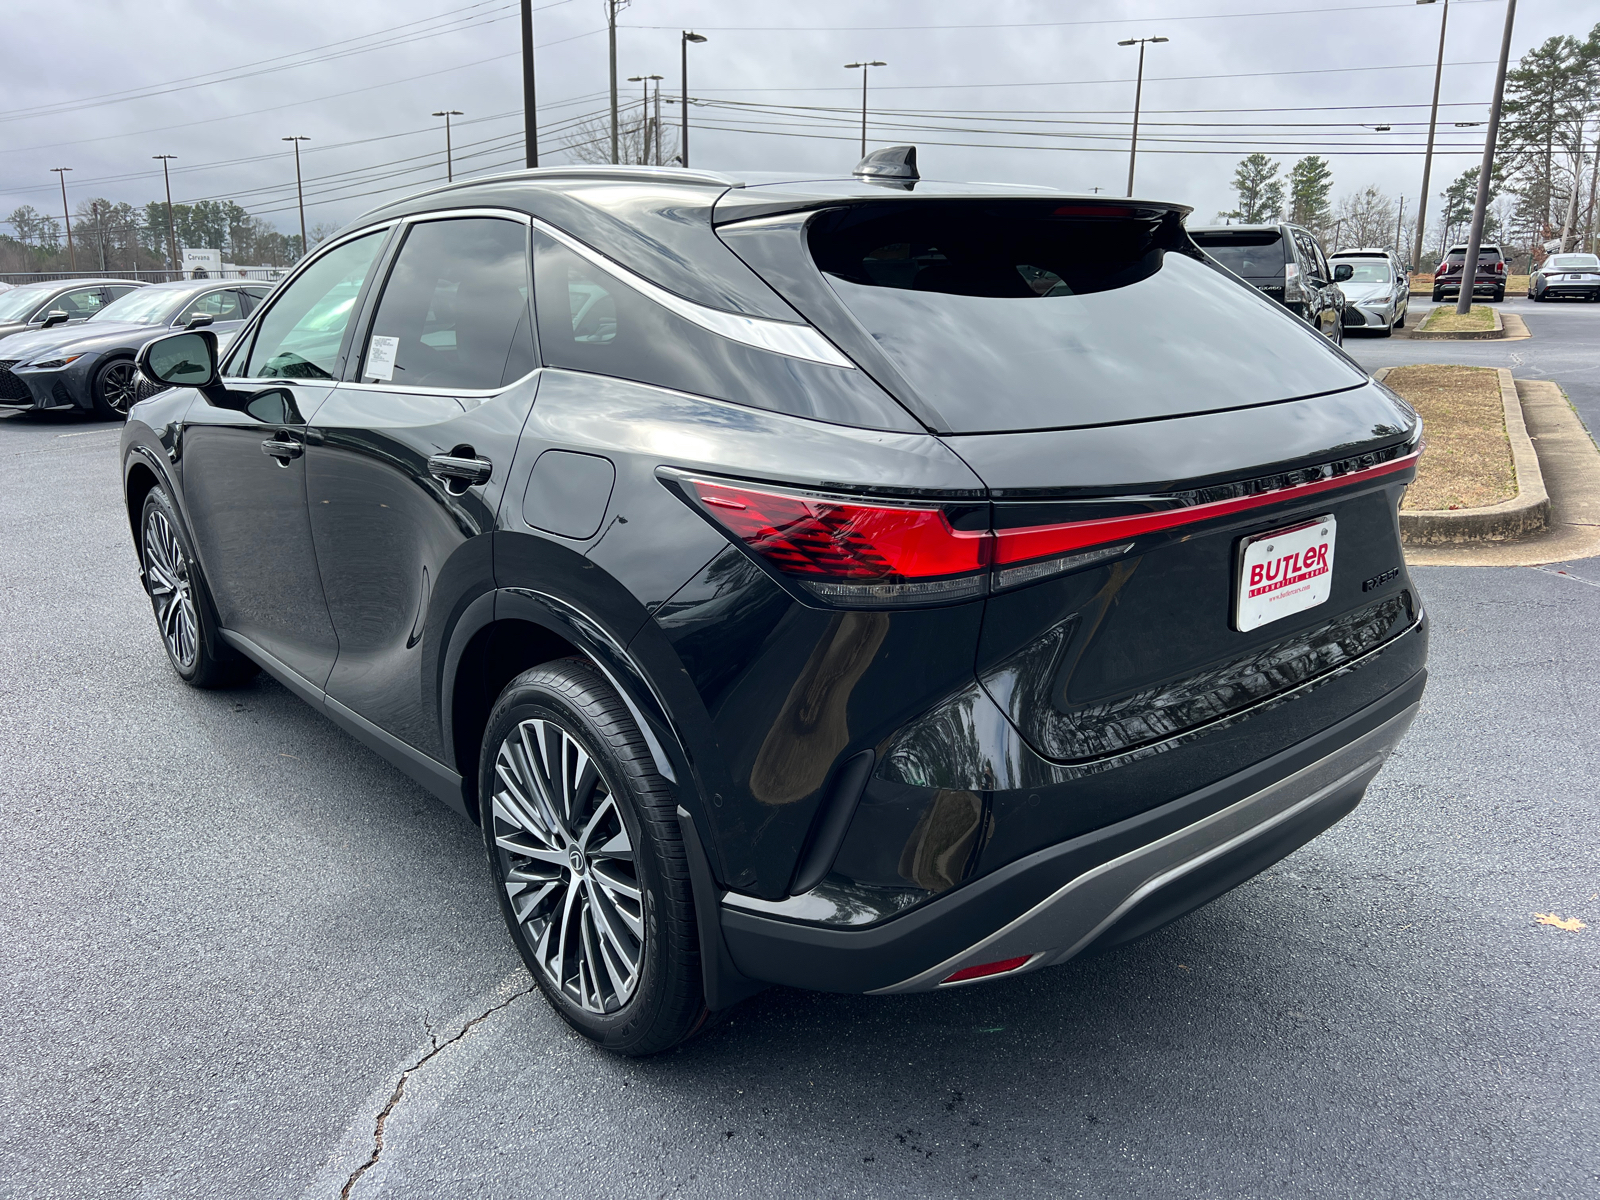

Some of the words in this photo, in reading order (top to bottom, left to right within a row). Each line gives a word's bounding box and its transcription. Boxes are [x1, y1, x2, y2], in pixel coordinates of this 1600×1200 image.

[187, 253, 210, 261] Carvana
[1249, 575, 1299, 598] AUTOMOTIVE
[1305, 566, 1328, 579] GROUP
[1269, 584, 1311, 602] www.butlercars.com
[620, 888, 658, 1037] GOODEAR
